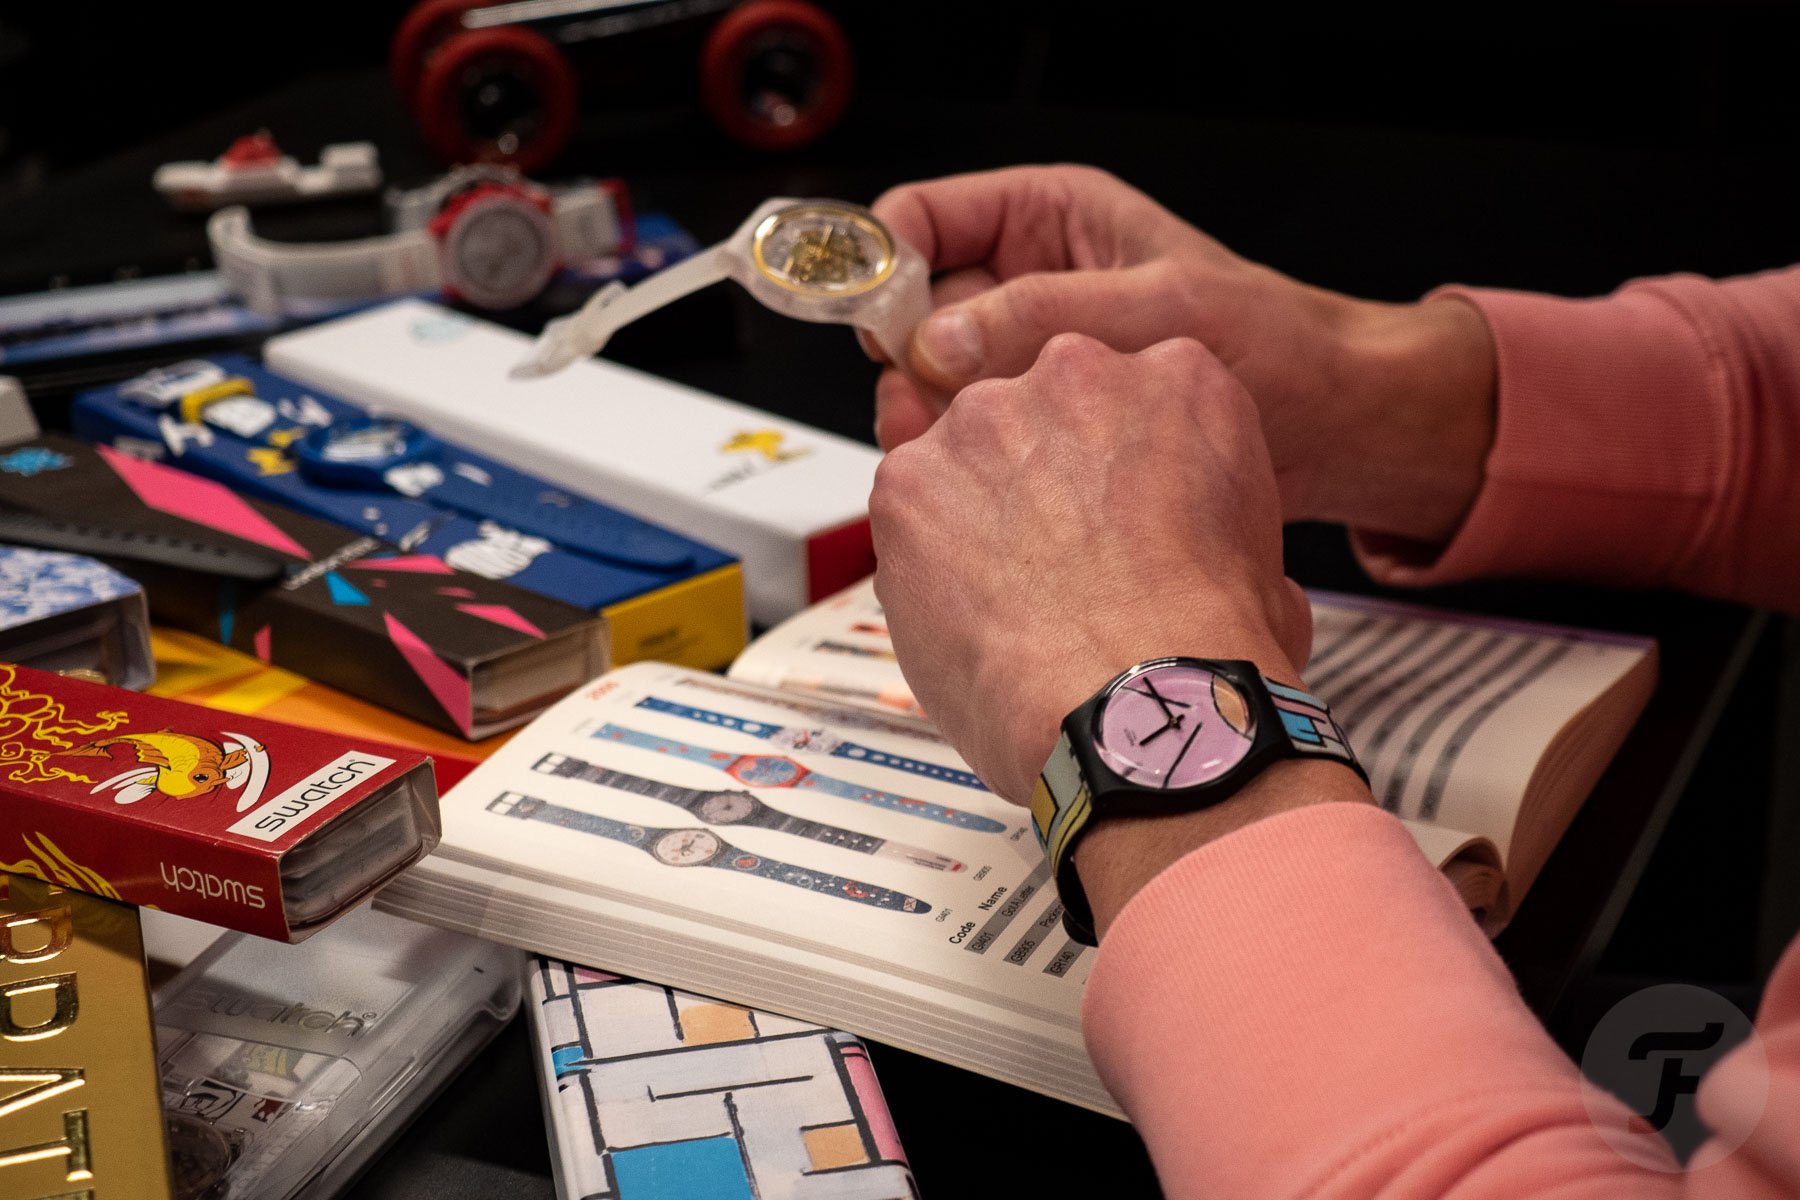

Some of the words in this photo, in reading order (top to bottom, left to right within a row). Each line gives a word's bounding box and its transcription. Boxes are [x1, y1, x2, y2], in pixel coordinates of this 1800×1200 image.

[254, 759, 376, 833] swatch
[160, 861, 266, 909] swatch
[948, 921, 976, 944] Code
[977, 886, 1008, 911] Name
[1049, 950, 1075, 973] GR140
